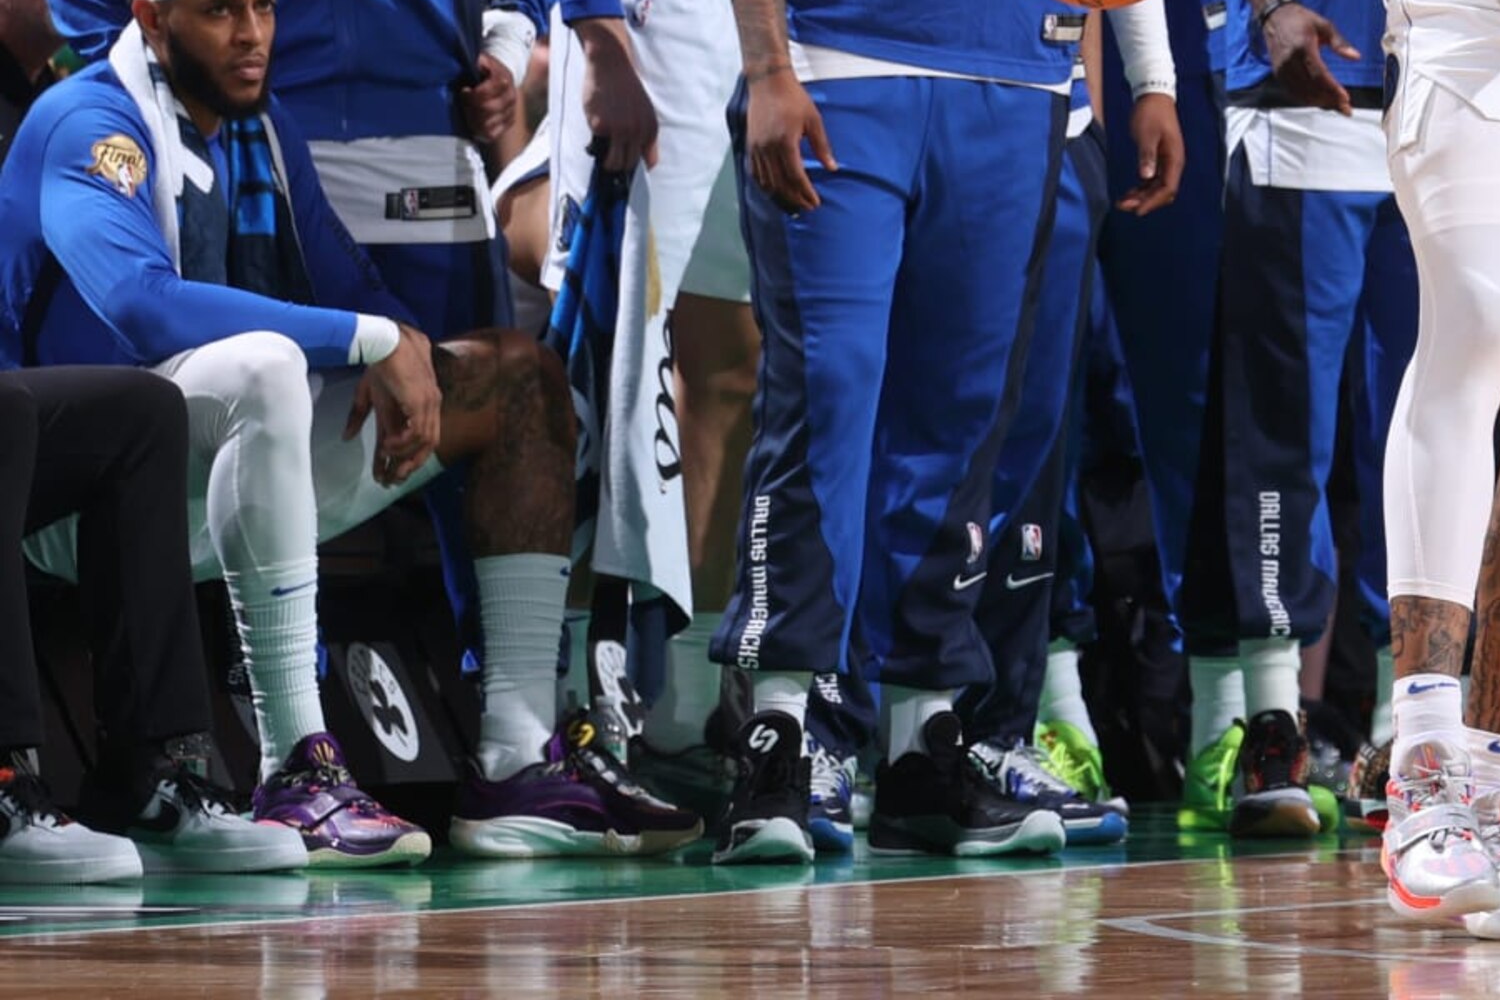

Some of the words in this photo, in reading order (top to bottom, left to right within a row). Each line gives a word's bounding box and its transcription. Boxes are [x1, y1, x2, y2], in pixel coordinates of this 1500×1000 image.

[750, 494, 771, 562] DALLAS
[1258, 490, 1281, 557] DALLAS
[737, 565, 770, 671] MAVERICKS
